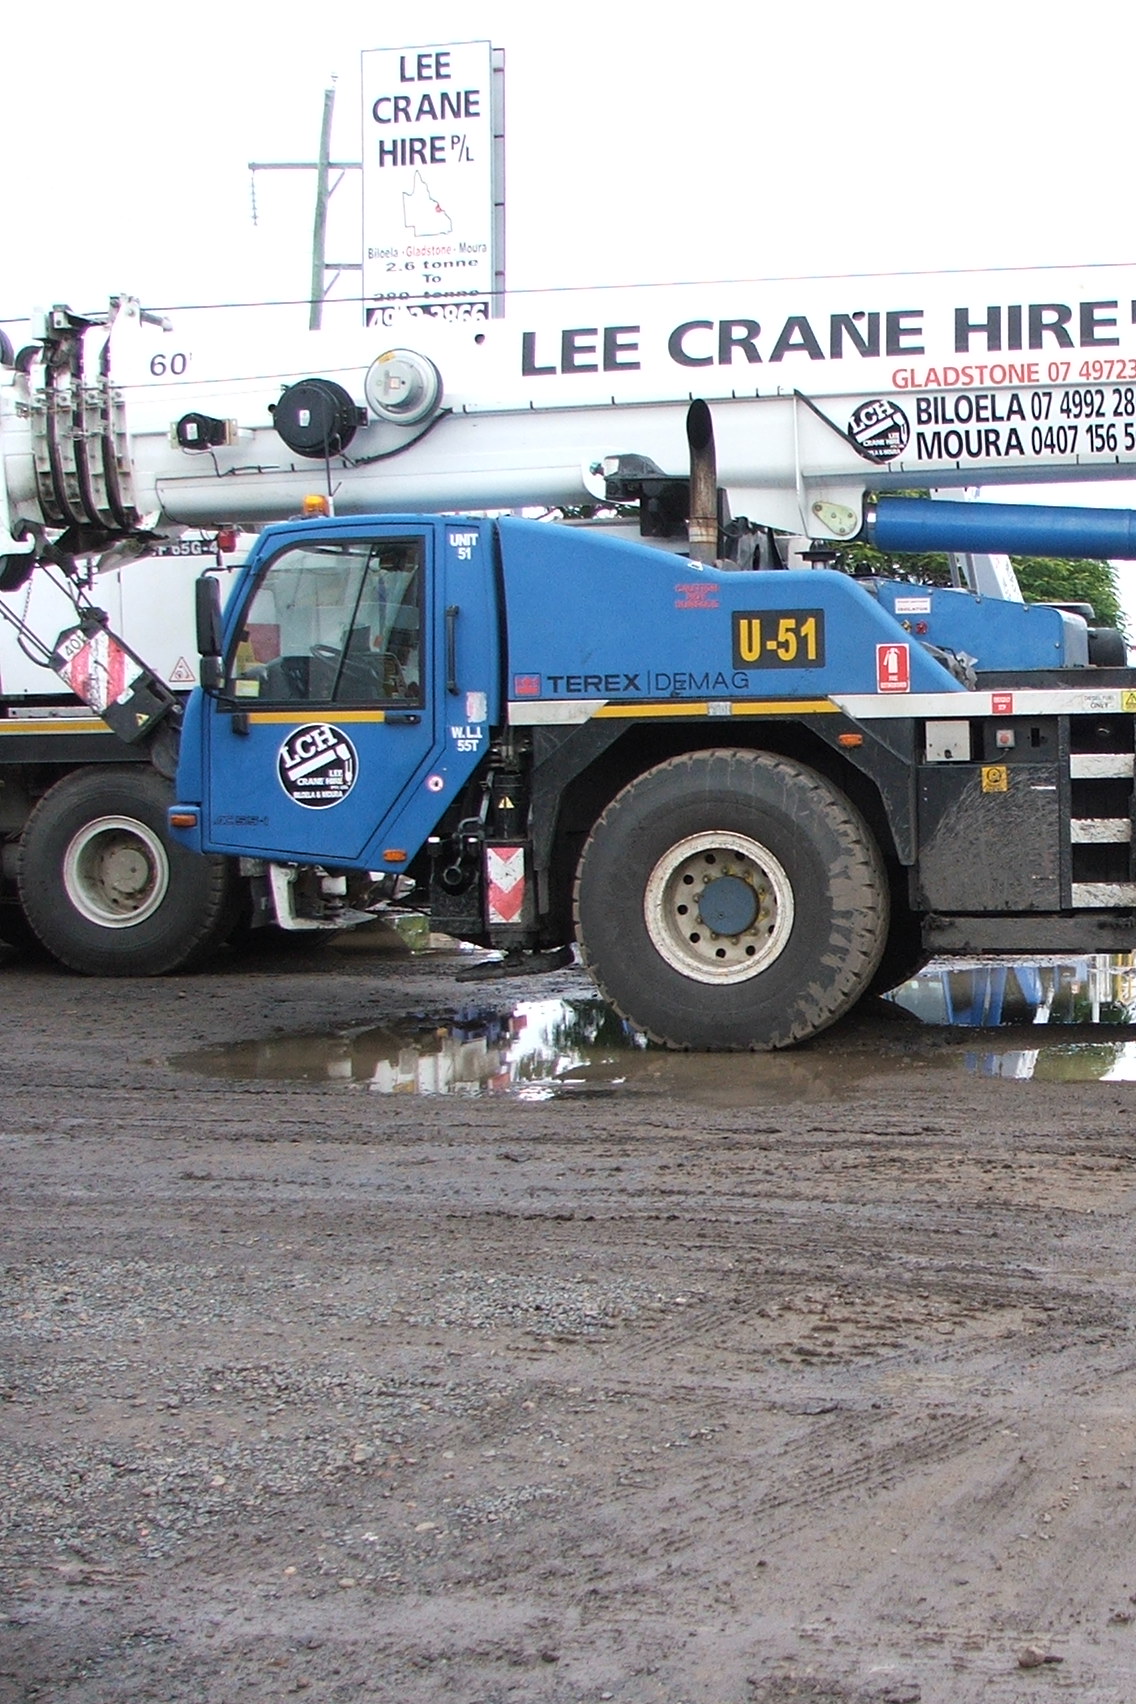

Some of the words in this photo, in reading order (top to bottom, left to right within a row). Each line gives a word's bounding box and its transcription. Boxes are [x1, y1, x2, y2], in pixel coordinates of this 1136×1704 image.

[400, 52, 451, 83] LEE
[372, 90, 480, 124] CRANE
[379, 136, 447, 167] HIRE
[451, 134, 475, 163] P/L
[368, 248, 399, 259] Biloela
[406, 245, 452, 257] Gladstone
[459, 242, 487, 253] Moura
[386, 261, 415, 272] 2.6
[423, 259, 479, 269] tonne
[422, 274, 442, 283] To
[522, 325, 641, 376] LEE
[668, 310, 925, 368] CRANE
[954, 300, 1120, 353] HIRE
[892, 362, 1040, 389] GLADSTONE
[1047, 361, 1071, 382] 07
[849, 400, 895, 434] LCH
[916, 393, 1026, 426] BILOELA
[1031, 391, 1053, 421] 07
[1060, 389, 1106, 419] 4992
[917, 428, 1025, 460] MOURA
[1031, 426, 1078, 455] 0407
[1085, 424, 1117, 453] 156
[450, 533, 479, 547] UNIT
[457, 547, 471, 560] 51
[740, 617, 816, 662] U-51
[547, 673, 641, 693] TEREX
[656, 671, 750, 691] DEMAG
[281, 726, 338, 768] LCH
[456, 739, 479, 752] 55T
